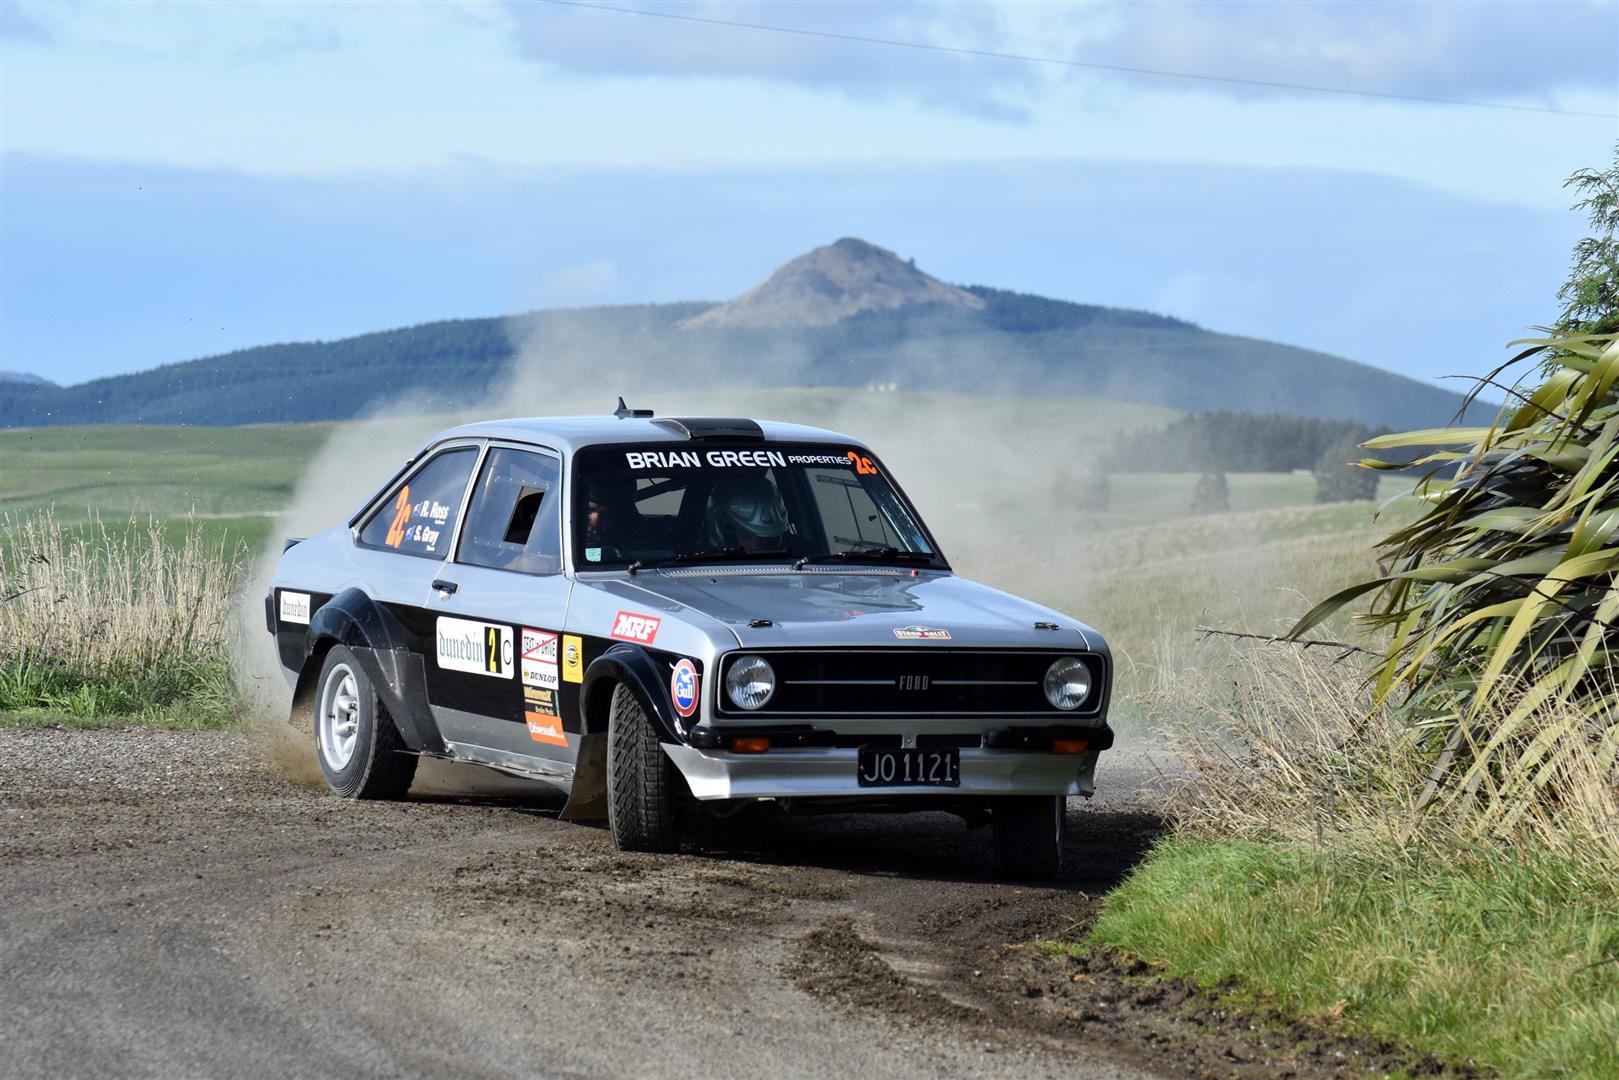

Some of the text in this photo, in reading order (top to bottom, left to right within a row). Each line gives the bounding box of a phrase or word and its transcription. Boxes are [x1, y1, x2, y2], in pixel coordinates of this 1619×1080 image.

[626, 451, 851, 469] BRIAN GREEN PROPERTIES
[420, 500, 449, 520] R. Ross
[414, 525, 439, 546] S. Gray
[613, 614, 659, 640] MRF
[439, 630, 483, 662] dunedin
[489, 628, 496, 673] 2
[530, 671, 556, 684] DUNLOP
[899, 675, 929, 691] FORD
[678, 682, 693, 699] Gull
[903, 753, 953, 782] 1121
